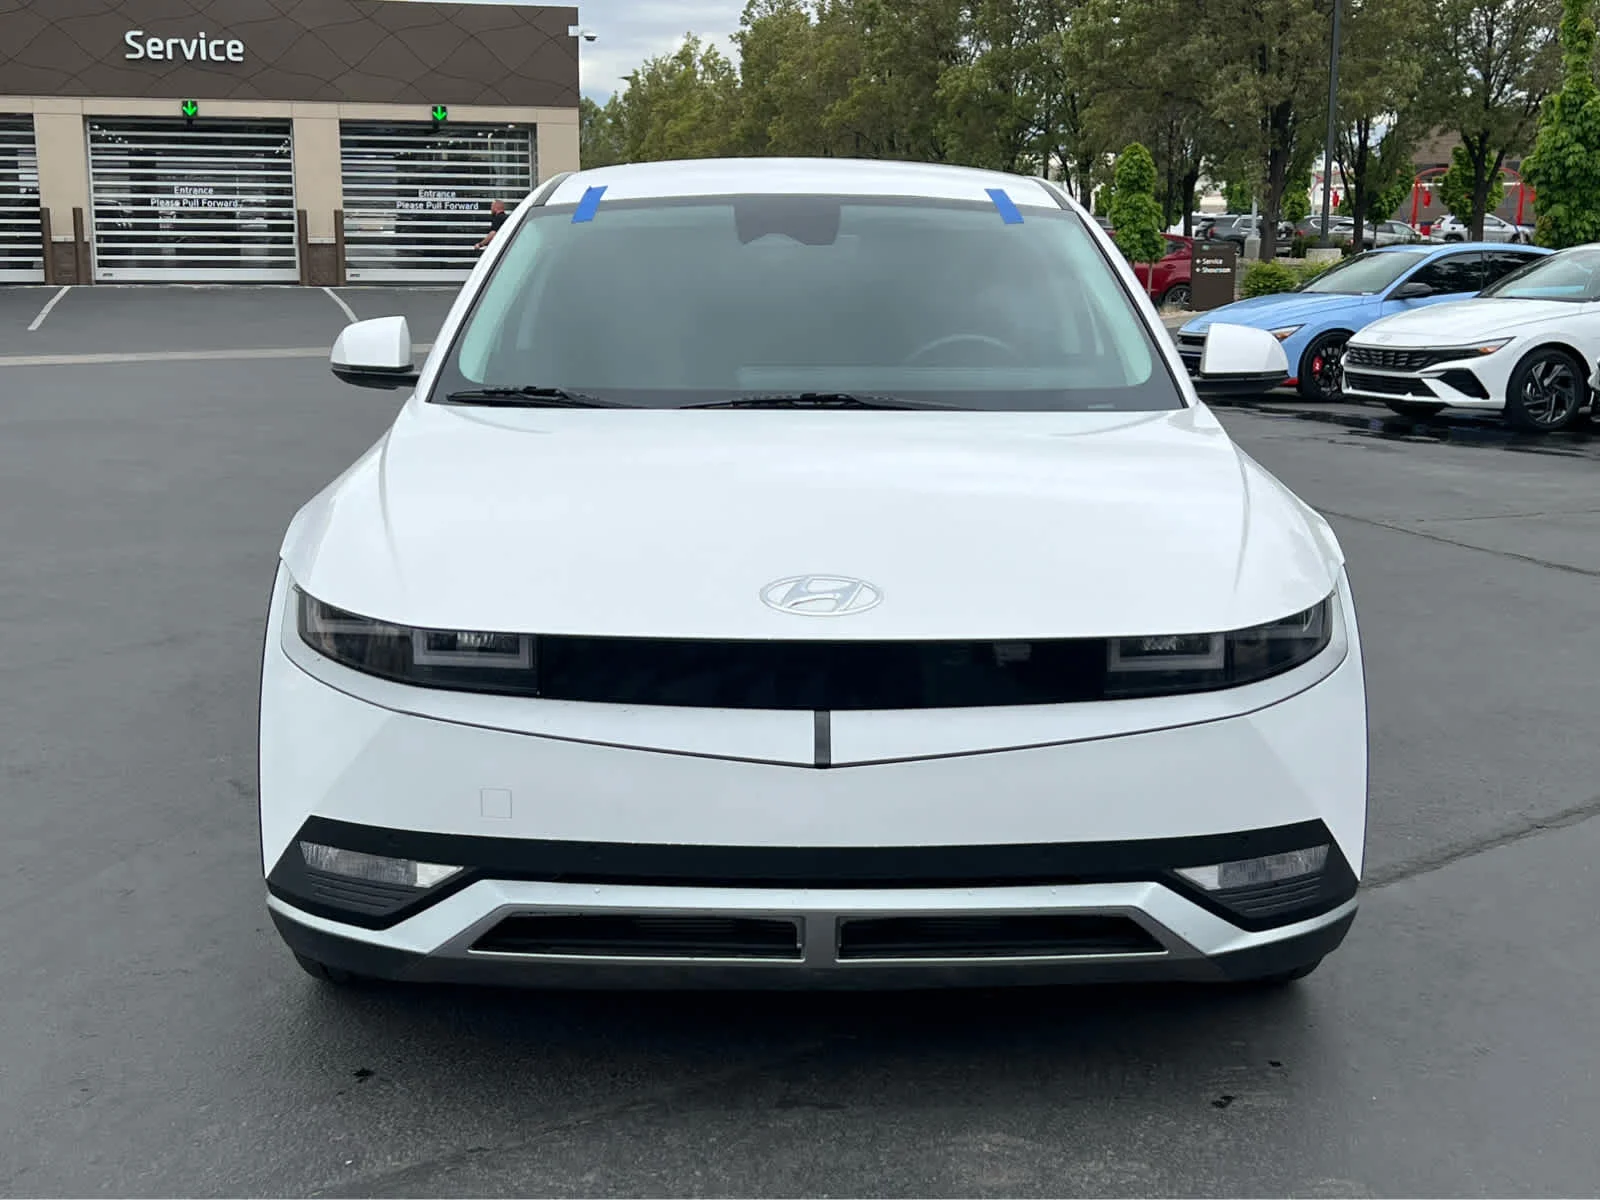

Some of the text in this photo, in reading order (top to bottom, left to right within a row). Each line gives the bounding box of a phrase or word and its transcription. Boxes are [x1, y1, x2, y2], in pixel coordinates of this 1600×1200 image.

[124, 30, 244, 62] Service
[173, 186, 214, 195] Entrance
[418, 189, 456, 198] Entrance
[150, 198, 238, 208] Please Pull Forward
[396, 200, 479, 211] Please Pull Forward
